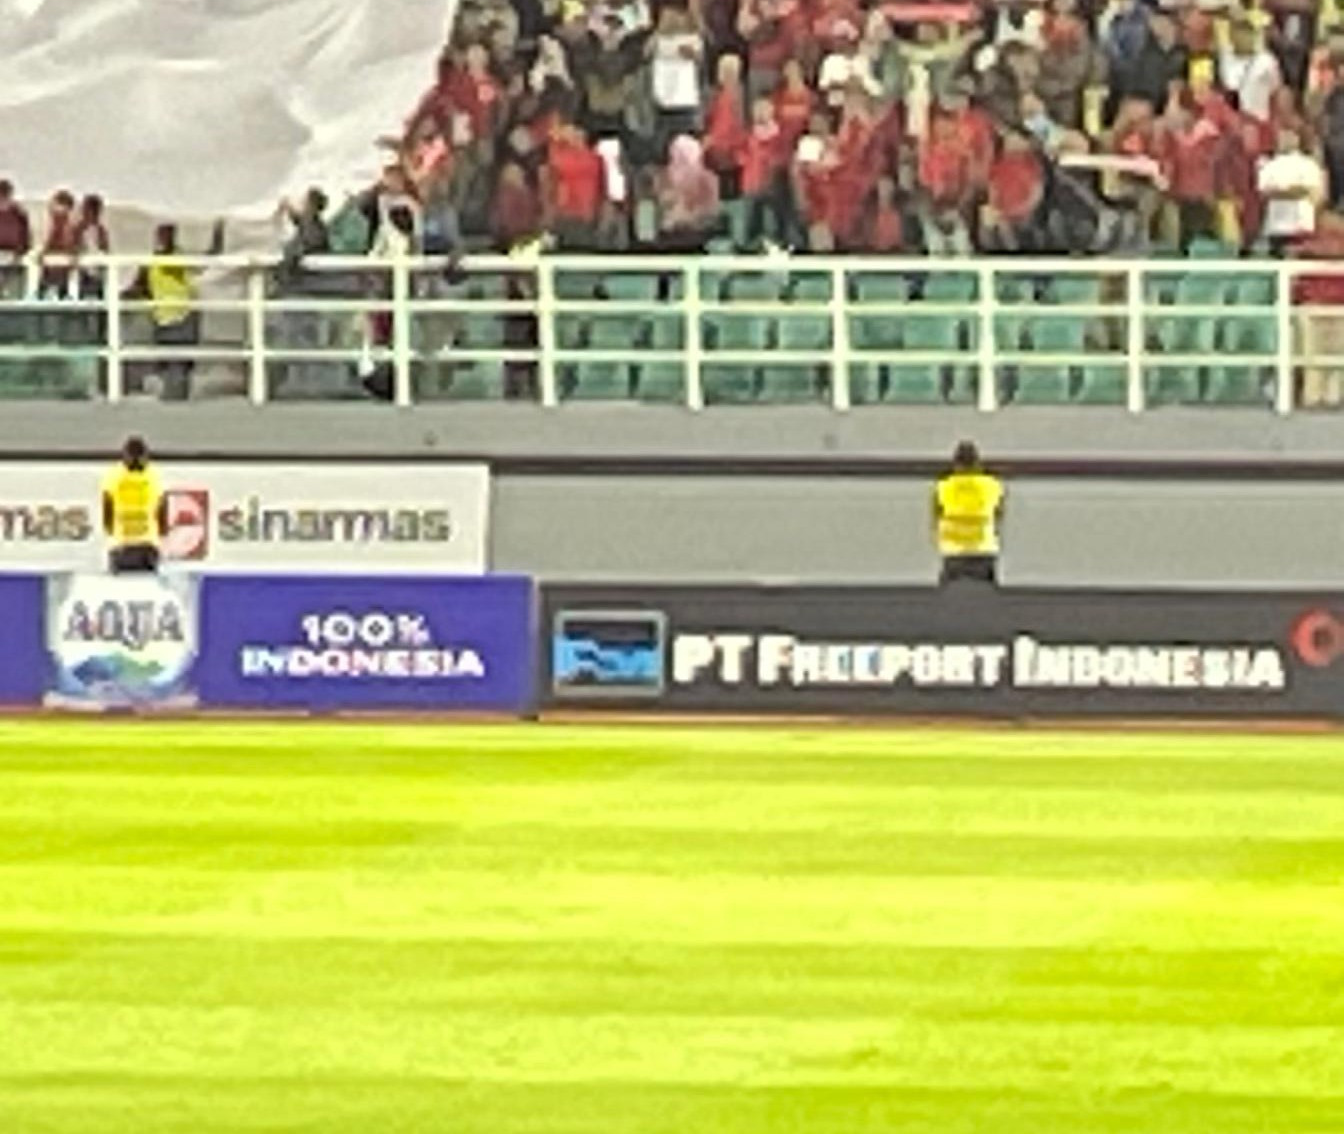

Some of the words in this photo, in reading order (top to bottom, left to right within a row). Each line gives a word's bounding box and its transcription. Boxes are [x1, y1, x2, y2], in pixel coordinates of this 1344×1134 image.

[218, 495, 450, 542] sinarmas
[64, 600, 183, 651] AQUA
[302, 614, 429, 645] 100%
[241, 647, 485, 677] INDONESIA
[673, 634, 752, 682] PT
